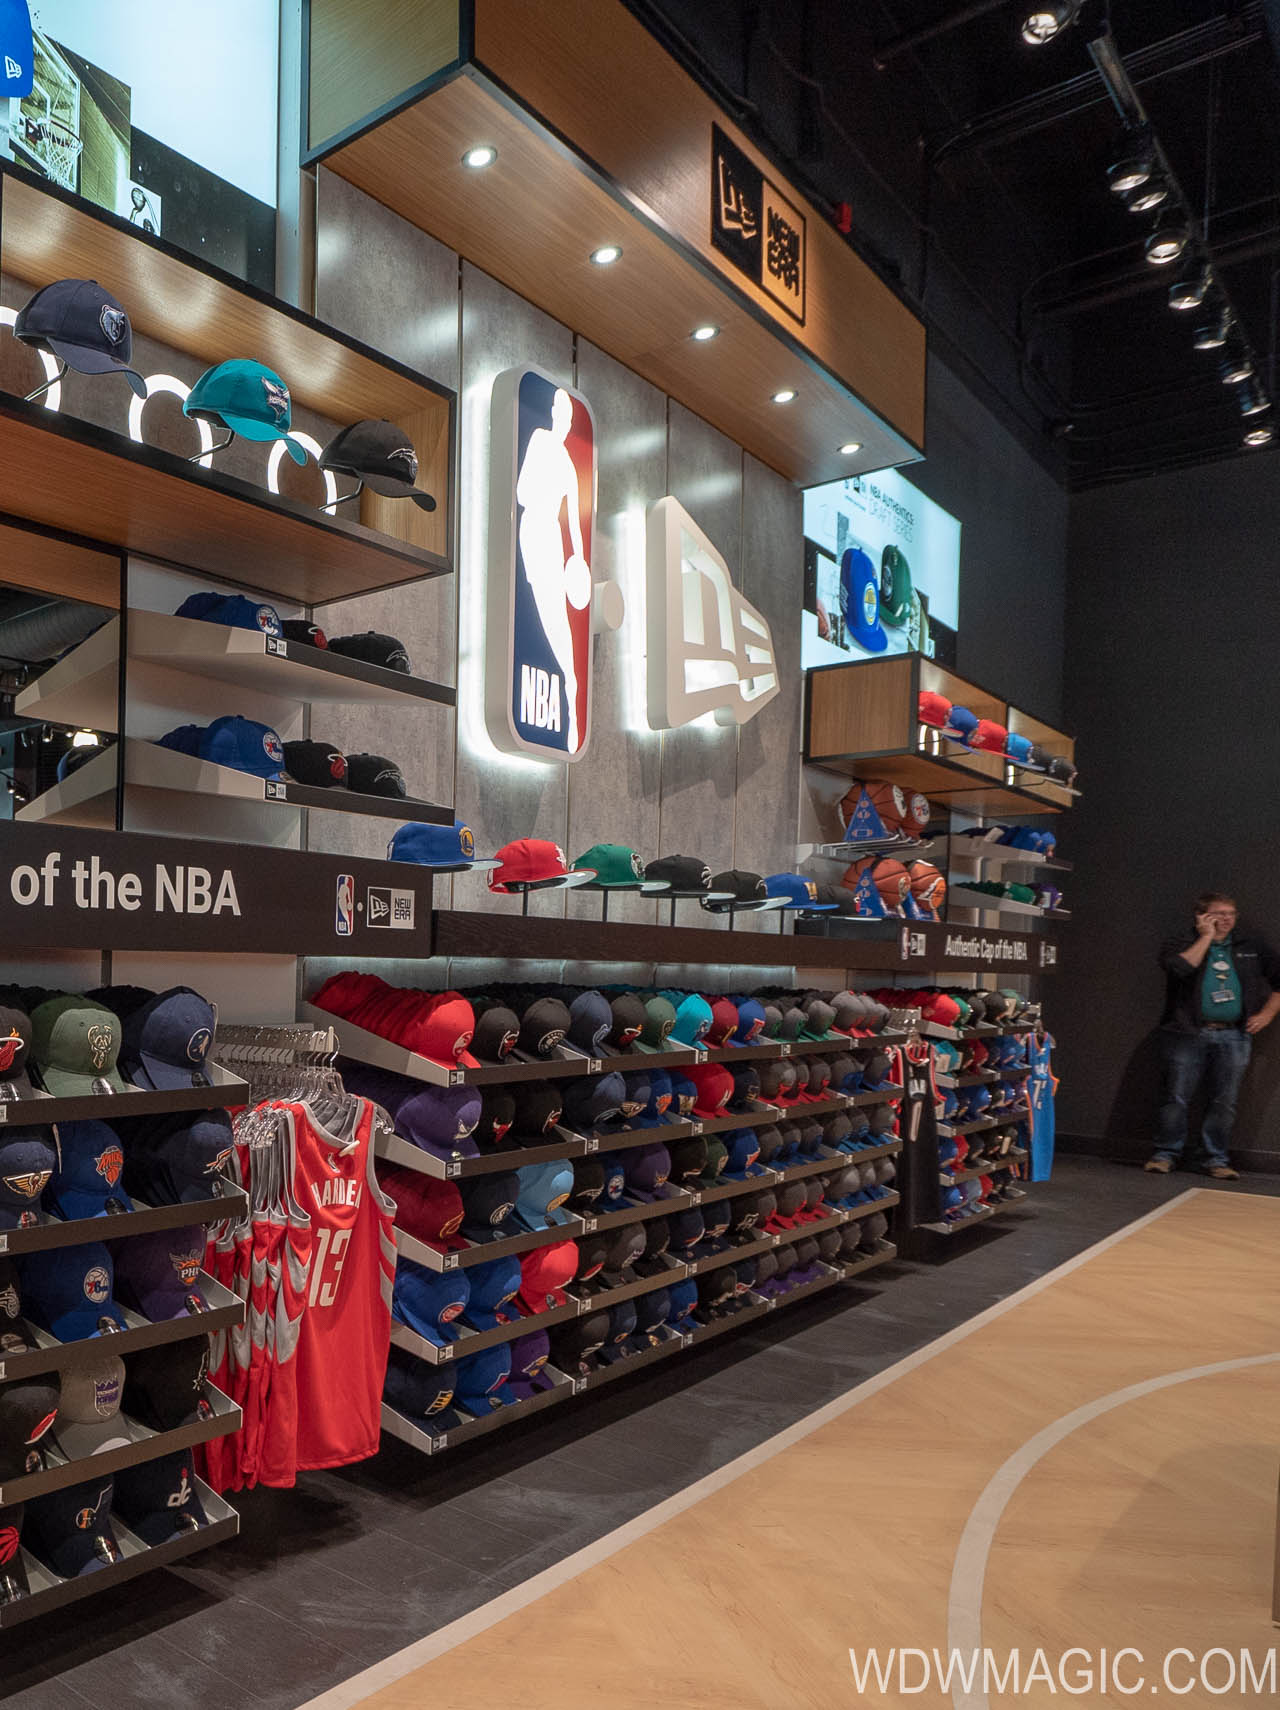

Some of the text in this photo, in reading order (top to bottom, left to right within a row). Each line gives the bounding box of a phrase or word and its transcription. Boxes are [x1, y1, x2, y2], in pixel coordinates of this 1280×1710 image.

[767, 206, 800, 264] NEW
[767, 240, 800, 296] ERA
[521, 664, 561, 733] NBA
[10, 851, 61, 907] of
[71, 855, 143, 911] the
[155, 863, 242, 916] NBA
[394, 897, 412, 909] NEW
[394, 909, 411, 920] ERA
[980, 938, 995, 964] Cap
